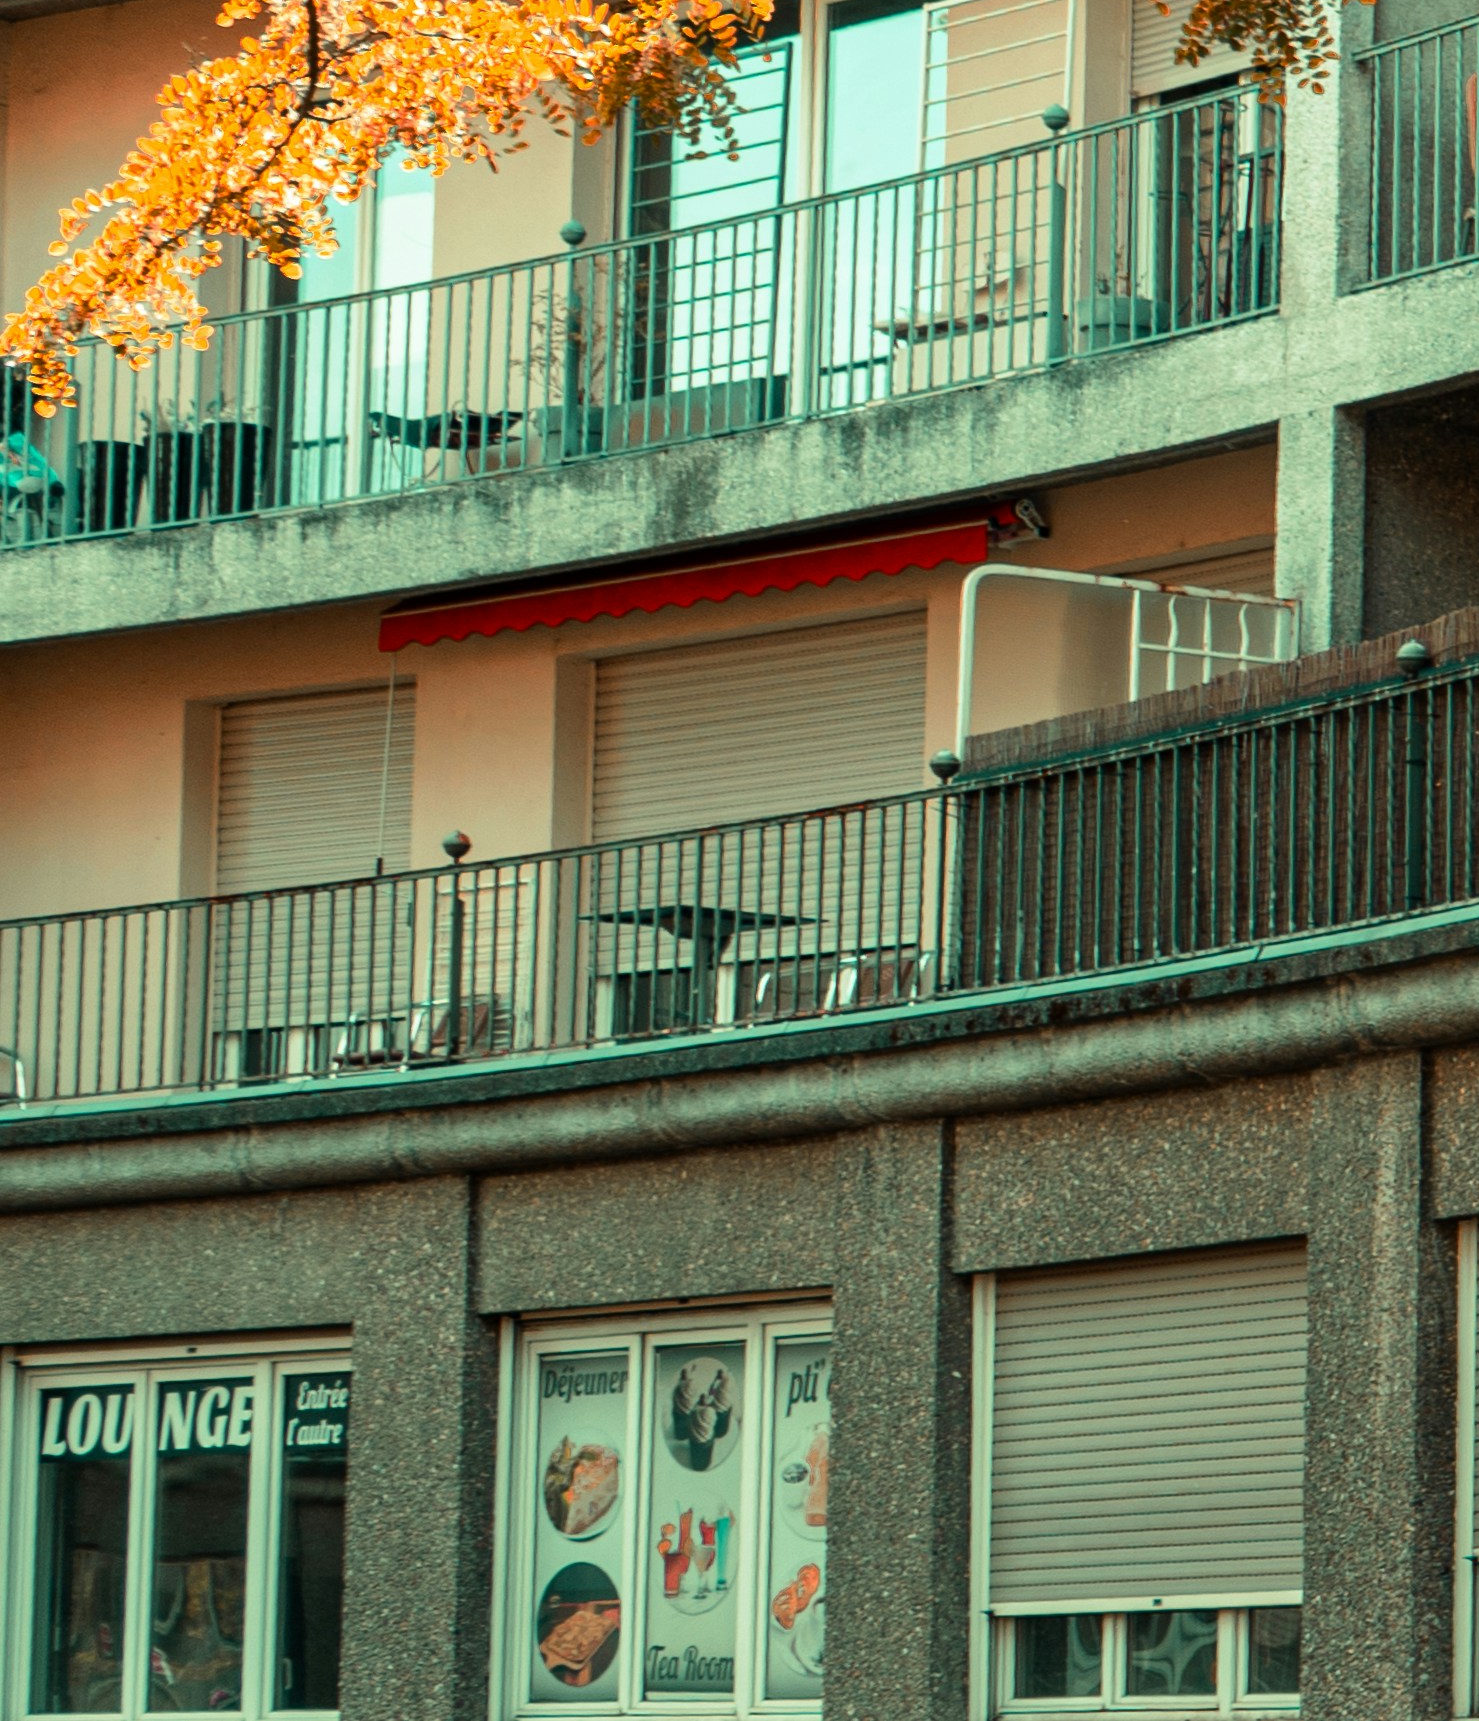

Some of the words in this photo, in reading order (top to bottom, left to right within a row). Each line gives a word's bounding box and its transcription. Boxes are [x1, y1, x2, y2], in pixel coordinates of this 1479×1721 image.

[296, 1380, 349, 1410] Entrée
[543, 1365, 629, 1404] Déjeuner
[41, 1385, 253, 1456] LOUNGE
[647, 1645, 680, 1681] Tea
[683, 1645, 735, 1681] Room
